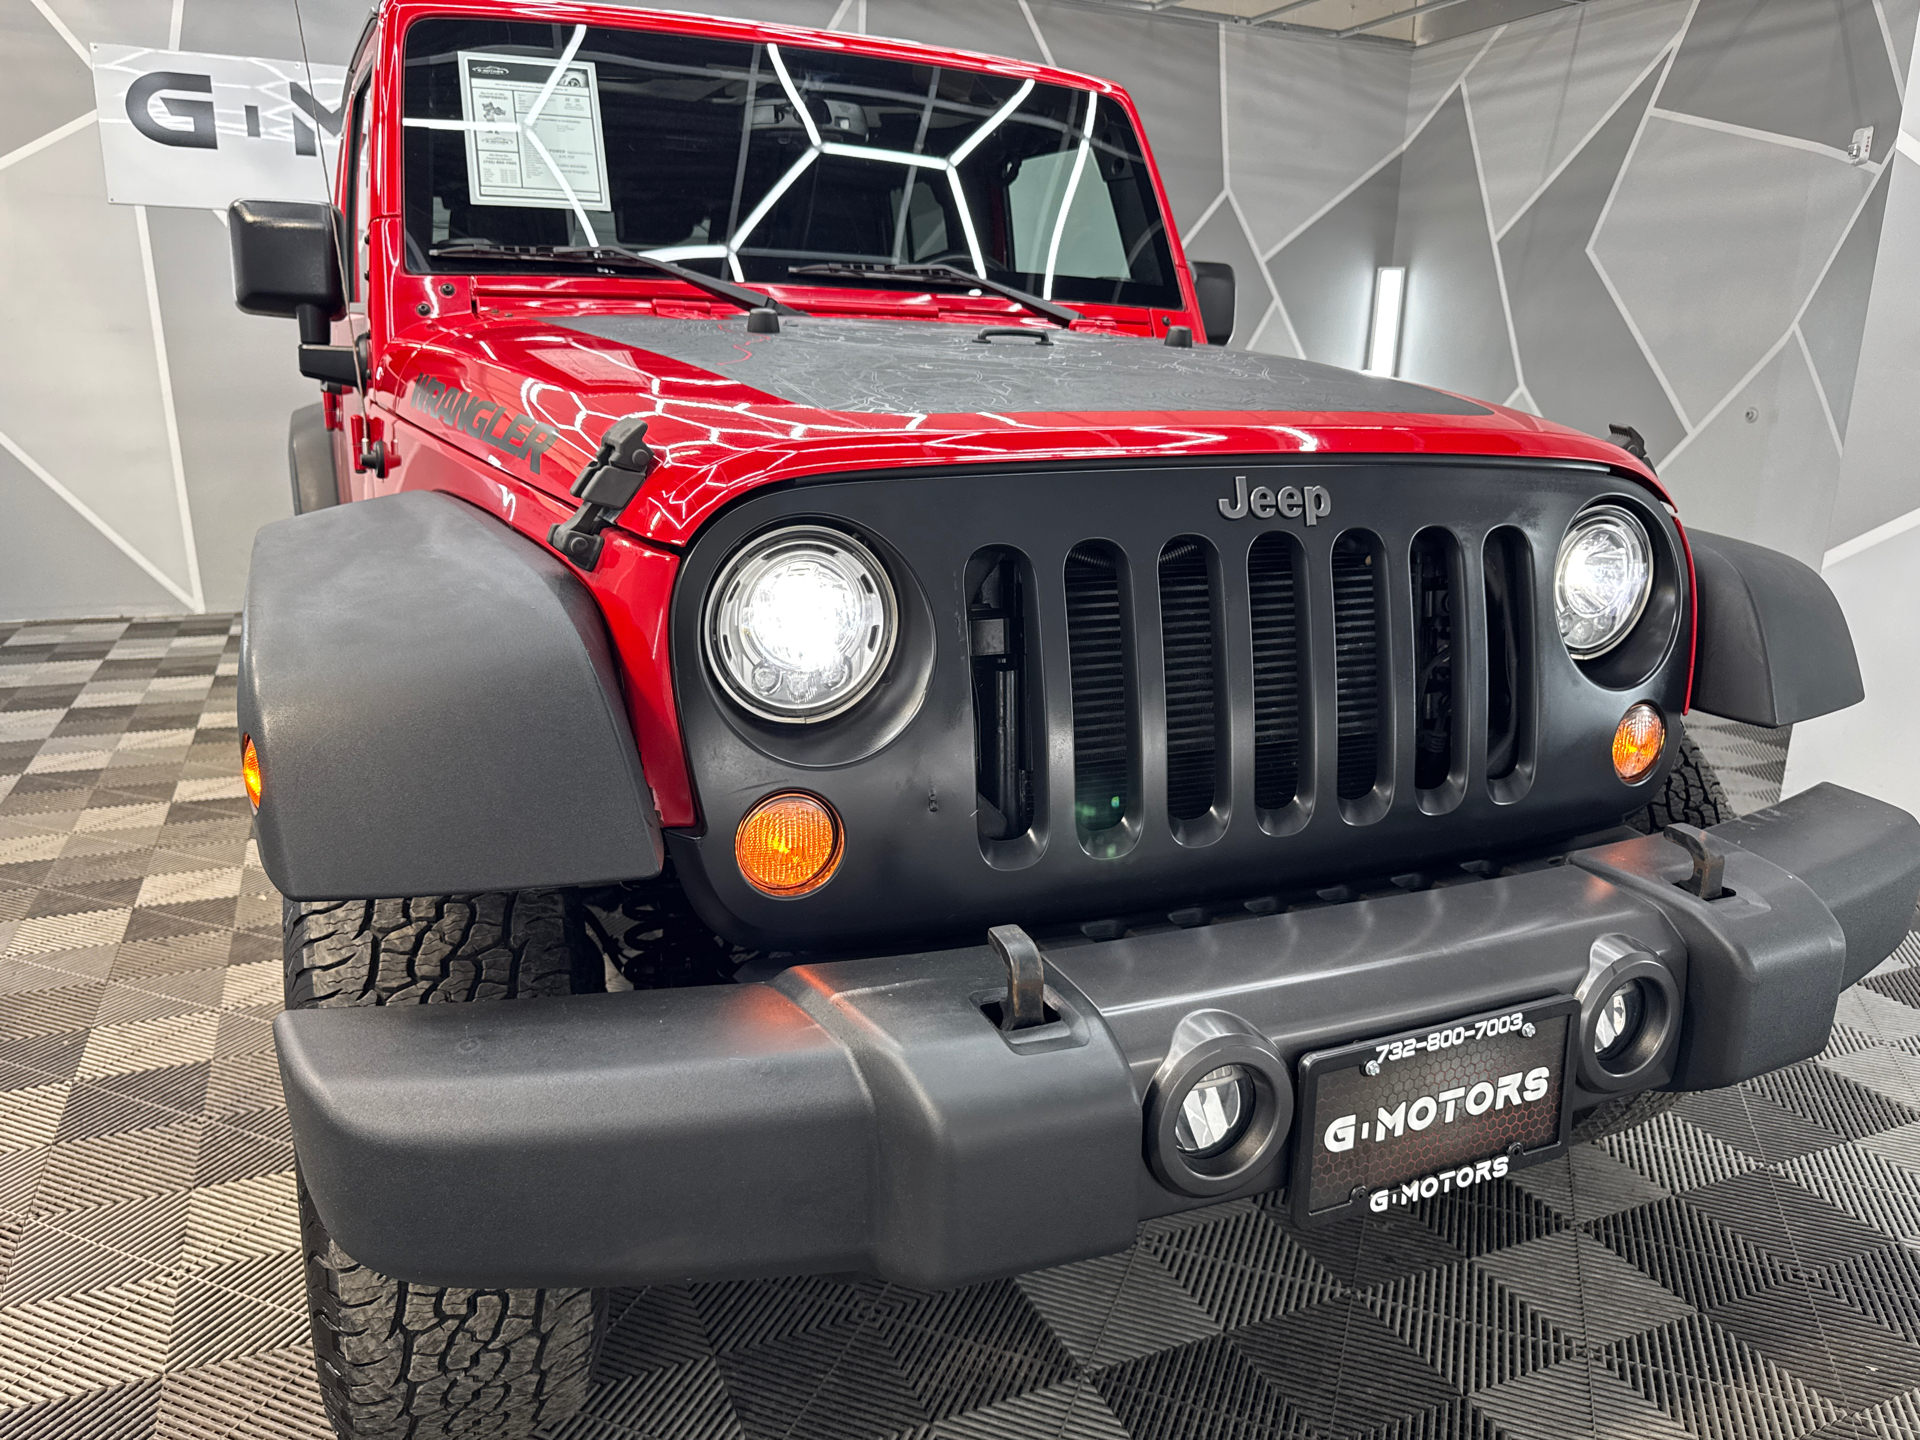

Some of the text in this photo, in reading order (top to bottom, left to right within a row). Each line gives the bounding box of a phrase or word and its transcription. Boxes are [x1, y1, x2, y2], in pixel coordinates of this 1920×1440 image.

[411, 372, 560, 475] WRANGLER
[1218, 476, 1331, 527] Jeep
[1375, 1012, 1523, 1064] 732-800-7003
